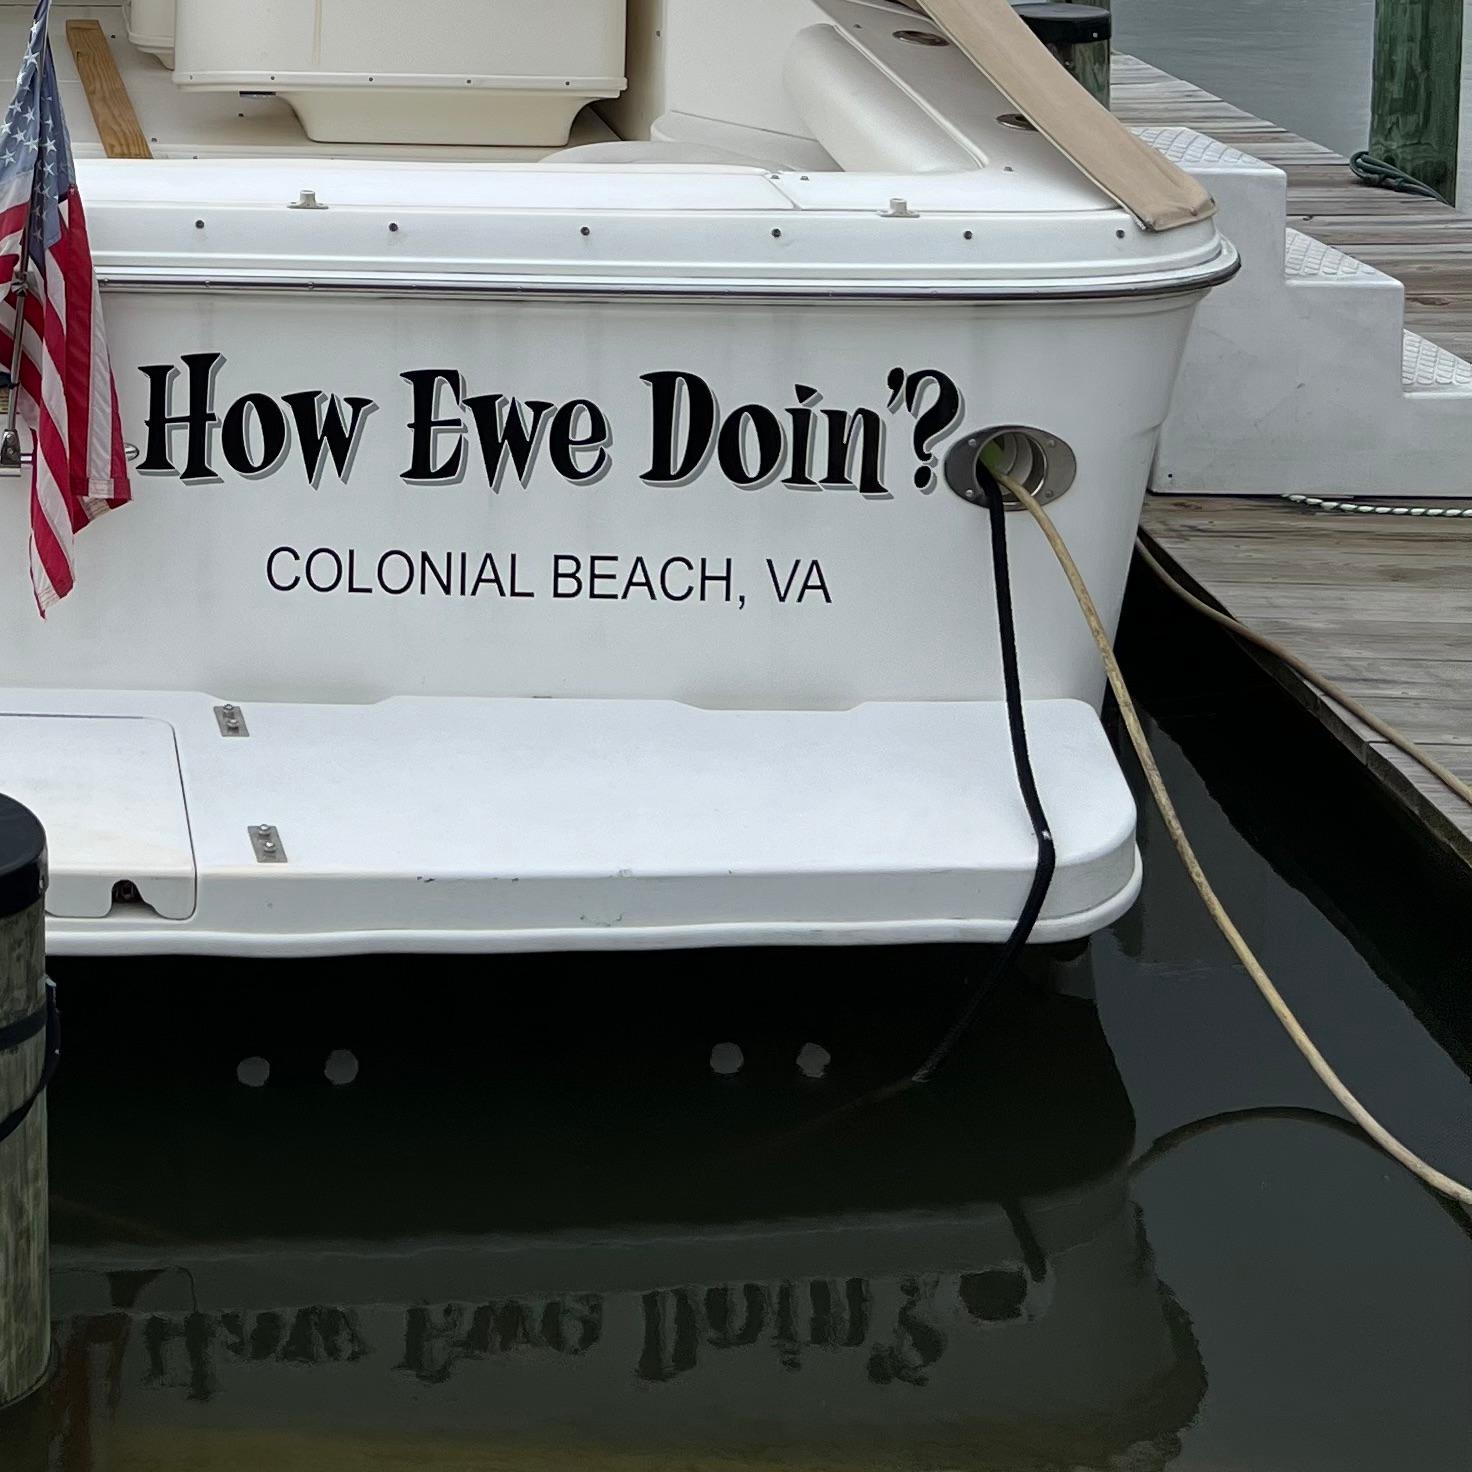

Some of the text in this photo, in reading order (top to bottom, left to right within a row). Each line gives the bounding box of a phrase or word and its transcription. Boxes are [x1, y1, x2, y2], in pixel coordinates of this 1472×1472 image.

[136, 353, 965, 500] How Ewe Doin'?
[266, 546, 832, 611] COLONIAL BEACH, VA
